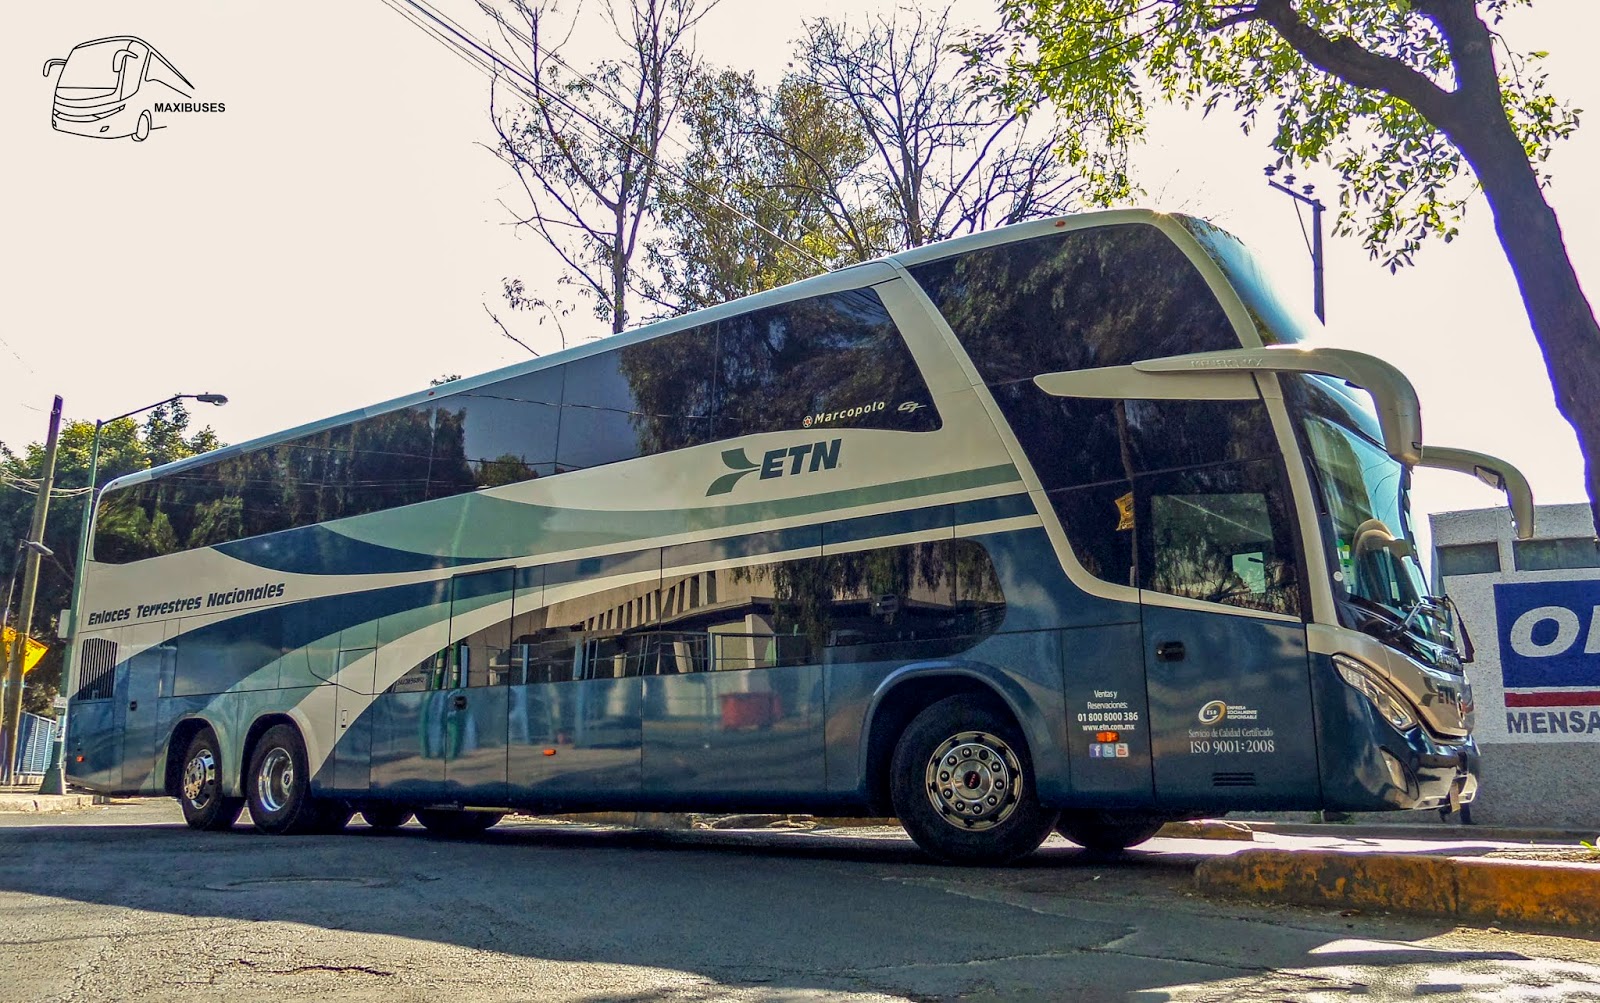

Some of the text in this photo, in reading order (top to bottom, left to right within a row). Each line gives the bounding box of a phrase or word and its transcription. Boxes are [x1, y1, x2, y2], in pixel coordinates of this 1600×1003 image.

[814, 401, 885, 424] Marcopolo
[759, 438, 842, 480] ETN
[88, 582, 285, 625] Enlaces Terrestres Nacionales
[1510, 605, 1600, 658] O
[1094, 690, 1113, 698] Ventas
[1077, 712, 1138, 721] 01 800 8000 386
[1188, 727, 1274, 738] Servicio de Calidad Certificado
[1190, 739, 1275, 756] ISO 9001:2008
